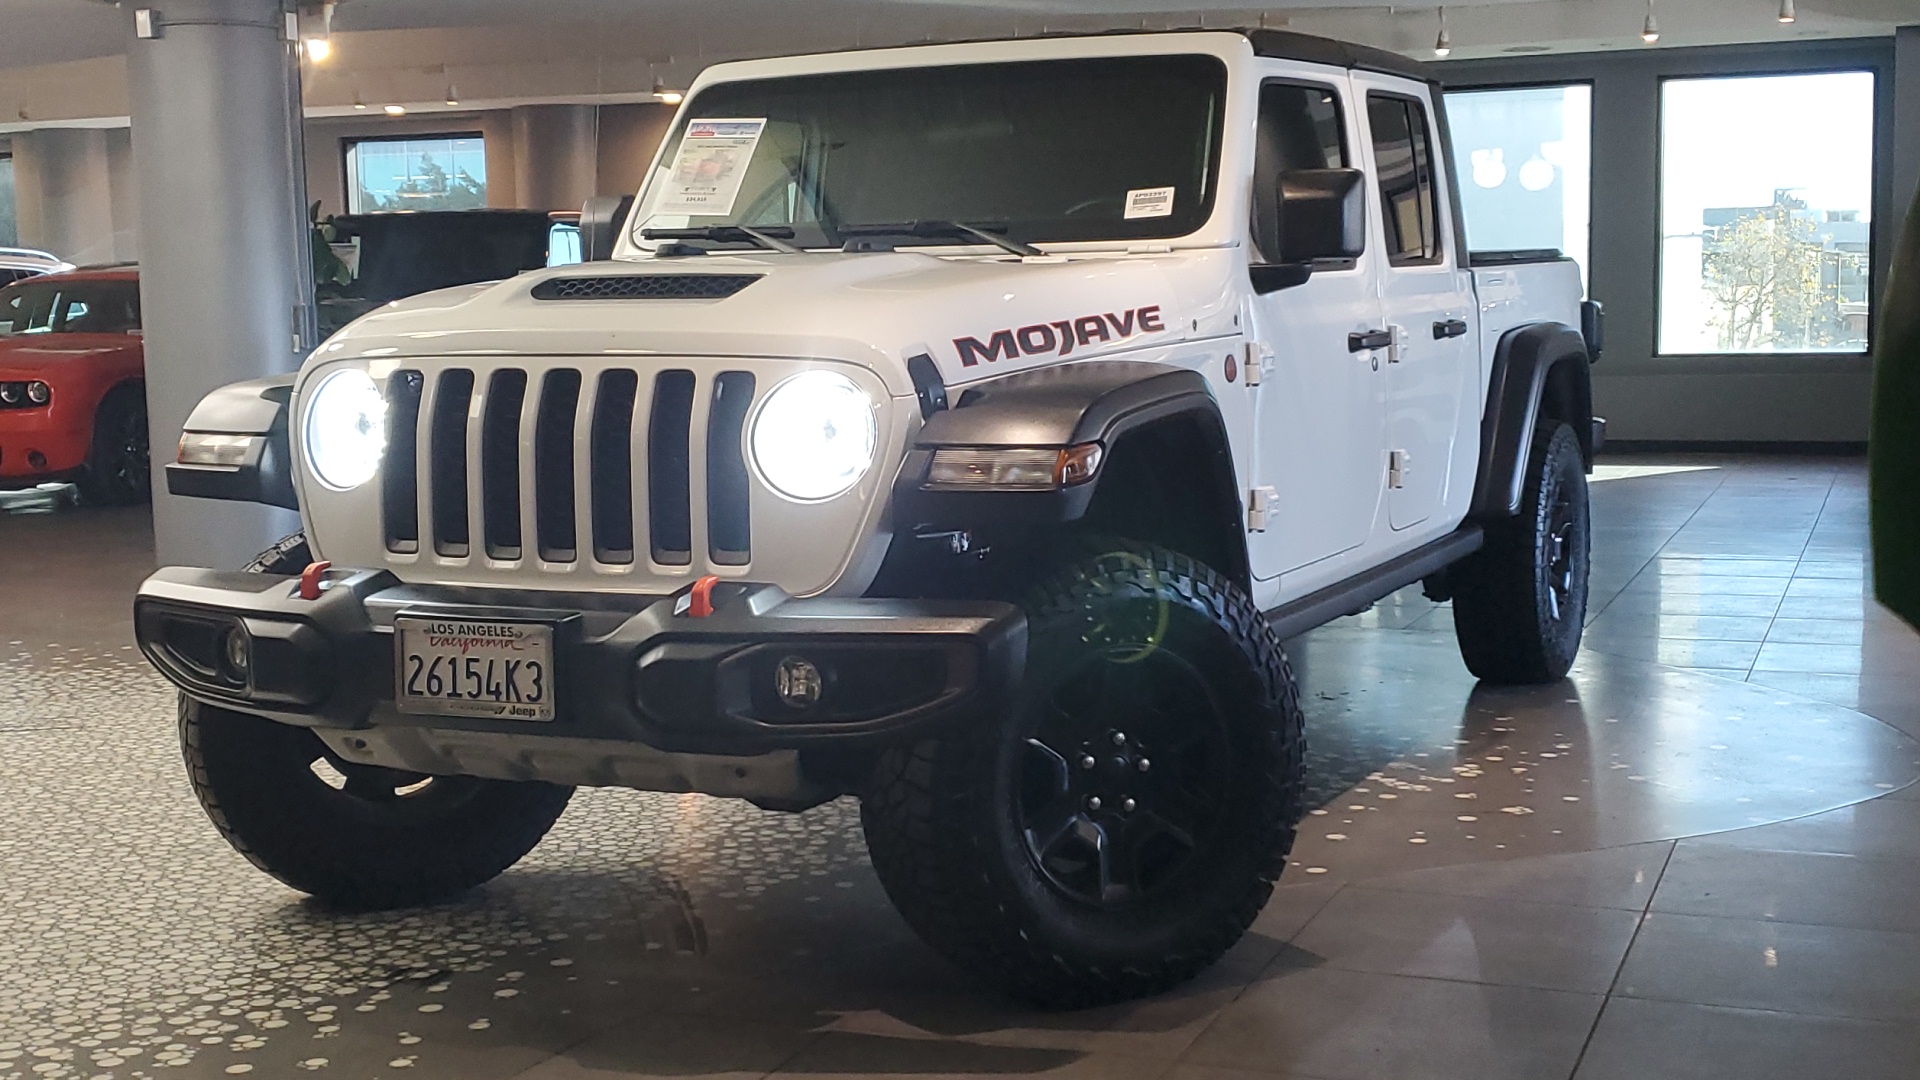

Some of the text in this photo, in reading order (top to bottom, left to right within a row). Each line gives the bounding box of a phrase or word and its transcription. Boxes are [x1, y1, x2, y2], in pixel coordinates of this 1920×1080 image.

[952, 305, 1166, 368] MOJAVE
[431, 623, 514, 638] LOS ANGELES
[407, 654, 543, 703] 26154K3
[509, 705, 536, 718] Jeep
